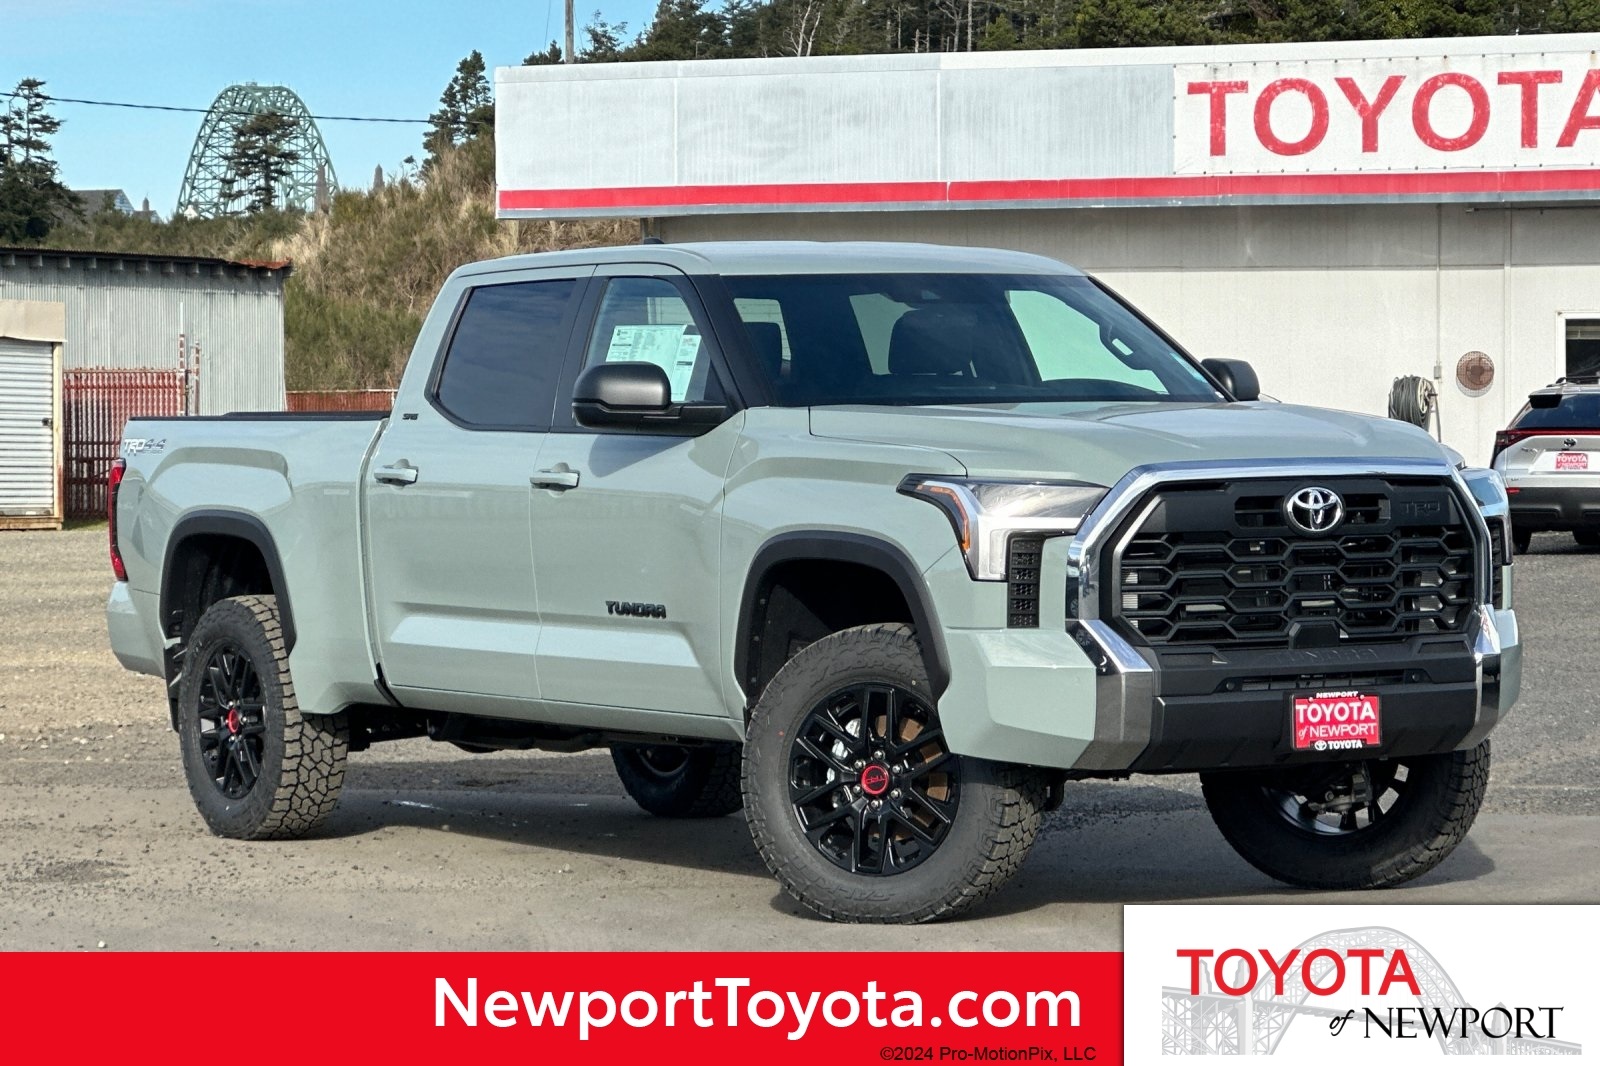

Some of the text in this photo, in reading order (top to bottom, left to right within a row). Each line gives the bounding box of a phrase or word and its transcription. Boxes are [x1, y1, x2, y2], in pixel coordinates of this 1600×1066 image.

[1187, 69, 1600, 156] TOYOTA
[1557, 453, 1587, 463] TOYOTA
[605, 600, 667, 619] TUNDRA
[1316, 691, 1359, 699] NEWPORT
[1295, 701, 1376, 723] TOYOTA
[1298, 722, 1377, 740] of NEWPORT
[1327, 739, 1363, 750] TOYOTA
